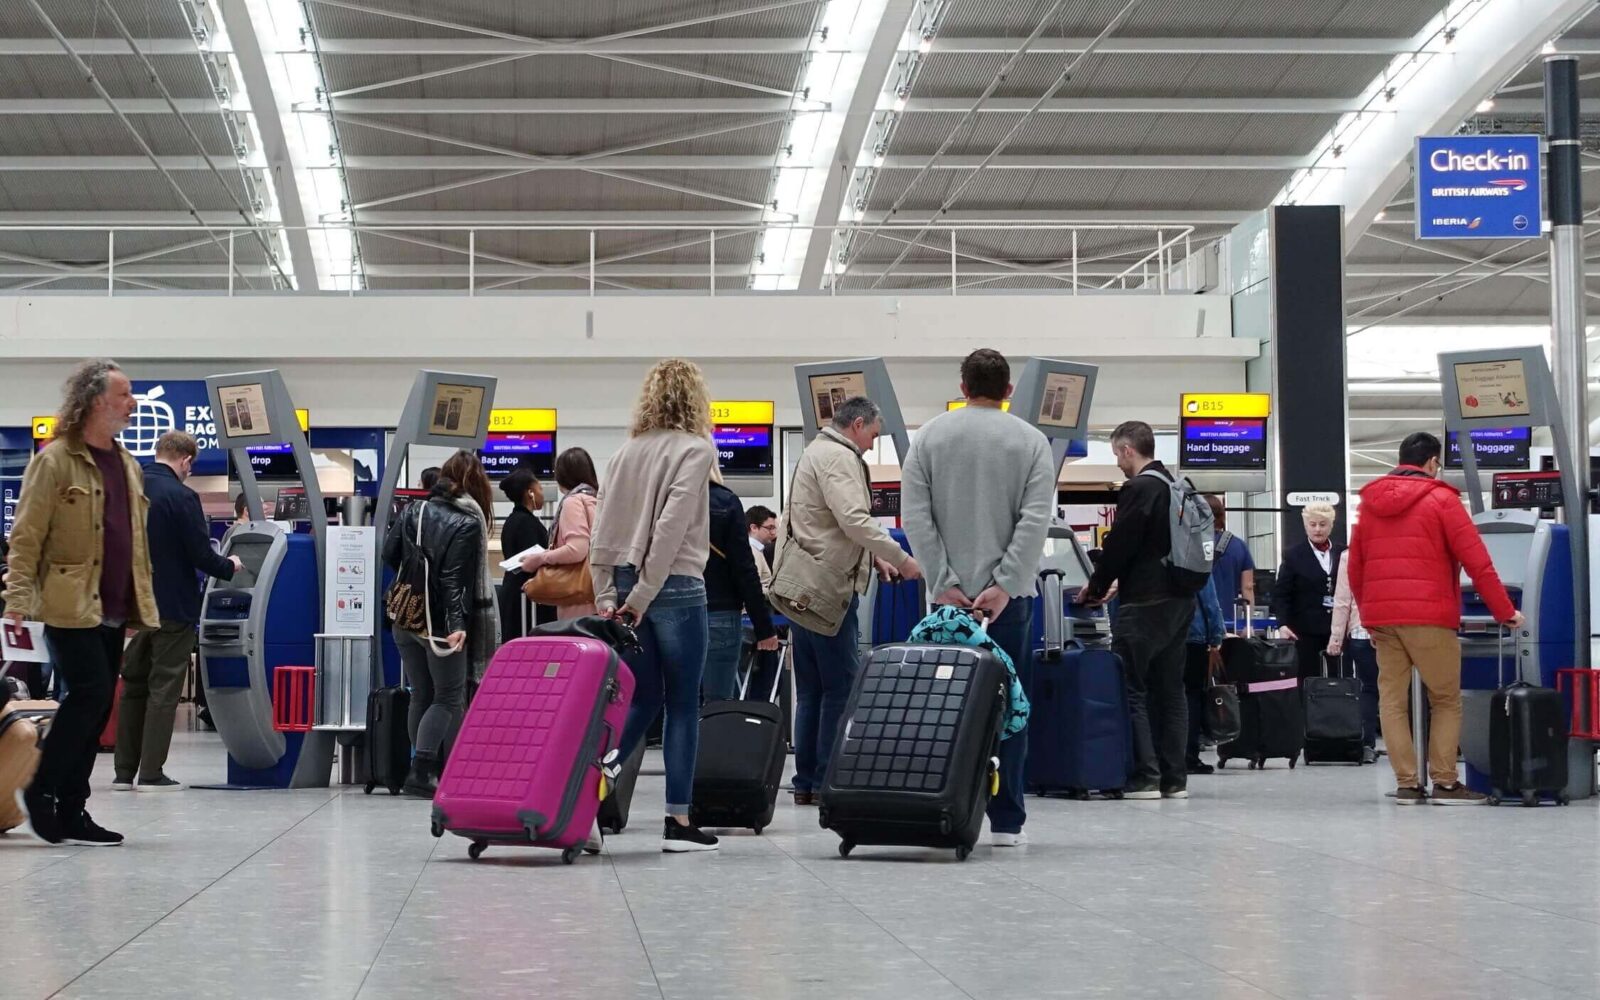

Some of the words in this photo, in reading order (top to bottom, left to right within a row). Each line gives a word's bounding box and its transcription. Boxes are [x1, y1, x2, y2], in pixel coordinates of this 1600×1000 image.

[1430, 149, 1527, 172] Check-in
[1431, 187, 1468, 197] BRITISH
[1469, 187, 1509, 197] AIRWAYS
[1202, 401, 1223, 410] B15
[185, 406, 214, 421] EX
[493, 416, 514, 425] B12
[1186, 443, 1210, 452] Hand
[1211, 443, 1250, 454] baggage
[1476, 443, 1515, 453] baggage
[251, 456, 271, 465] drop
[481, 456, 497, 466] Bag
[498, 455, 519, 466] drop
